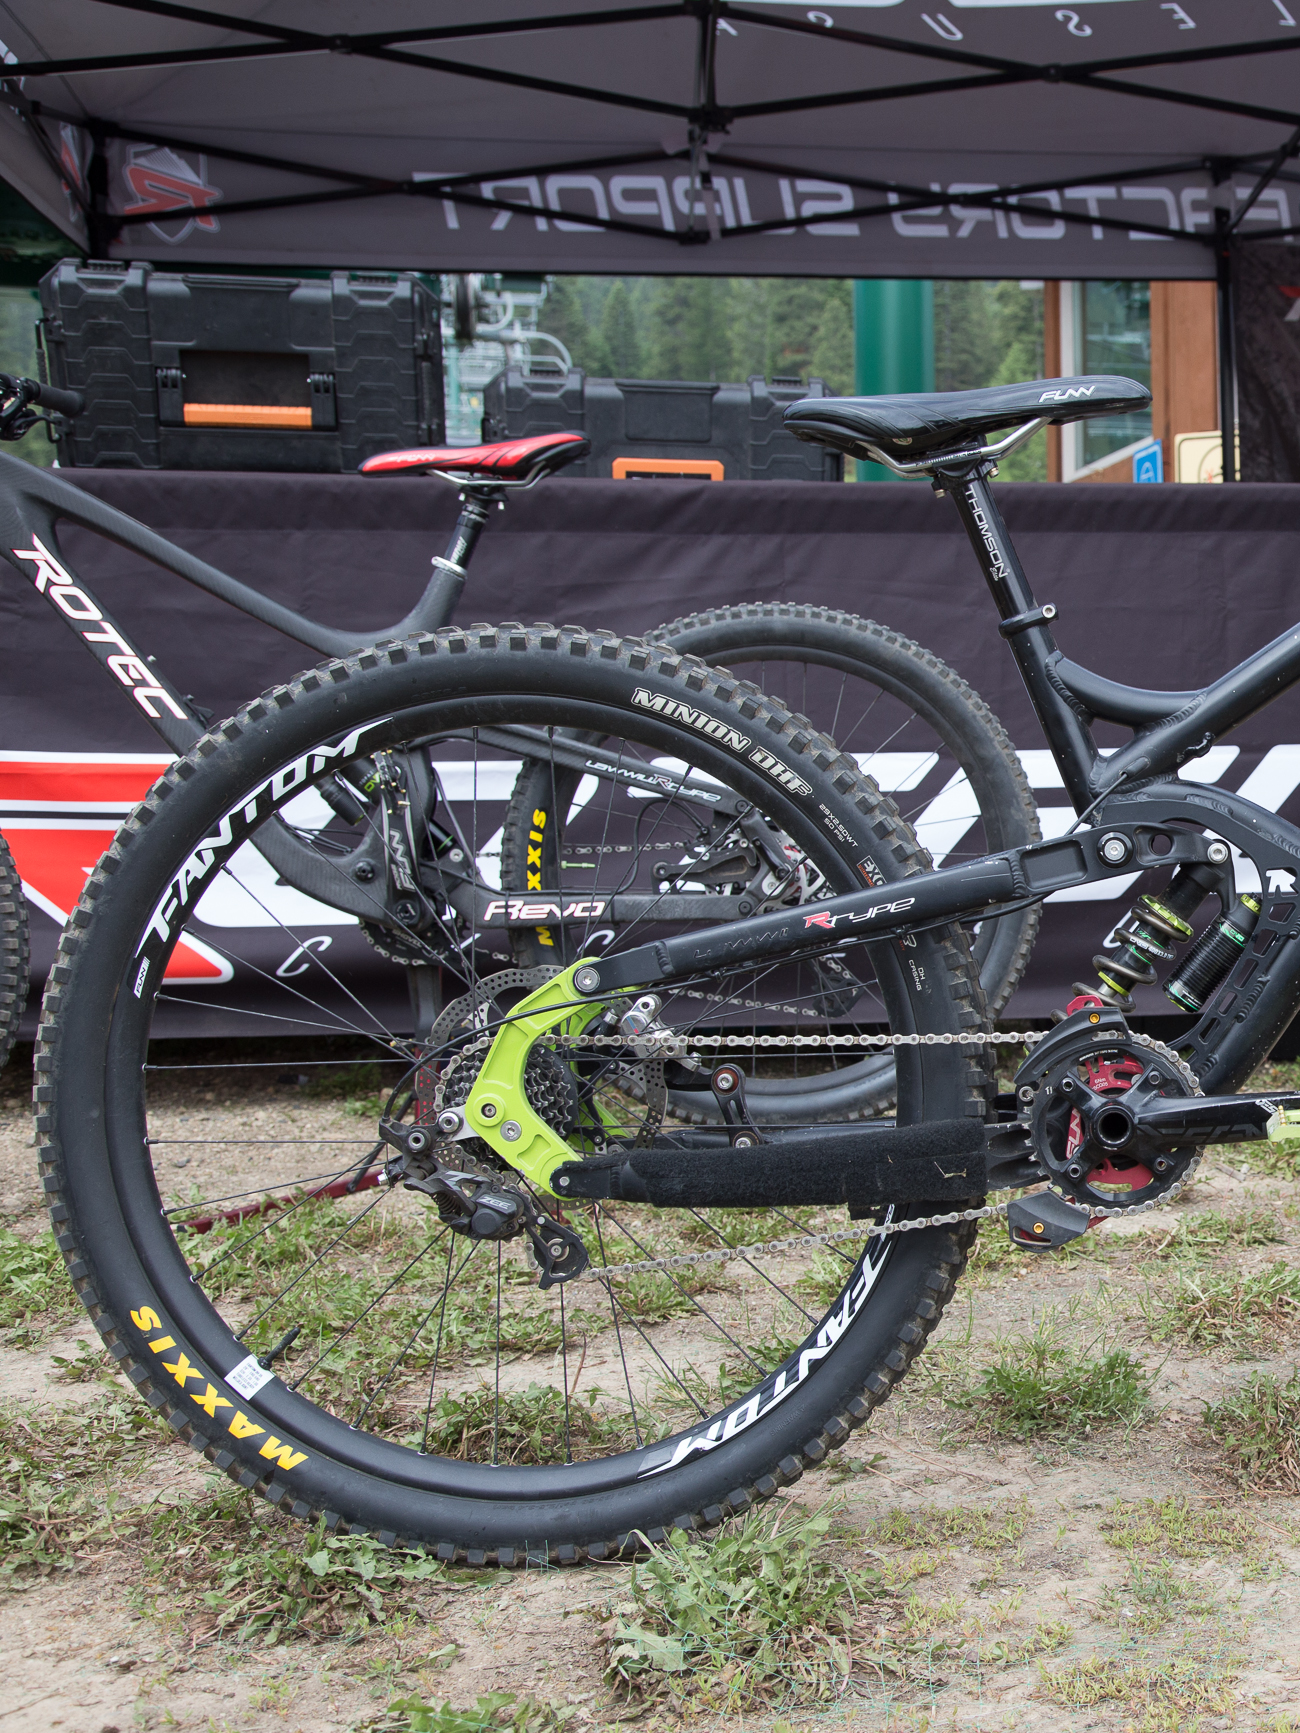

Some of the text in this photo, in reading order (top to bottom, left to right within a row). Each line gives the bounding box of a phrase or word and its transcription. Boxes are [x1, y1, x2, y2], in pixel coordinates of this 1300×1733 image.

[1039, 386, 1096, 403] FUNN
[964, 484, 1009, 578] THOMSON
[11, 532, 187, 721] ROTEC
[631, 687, 813, 797] MINION DHF
[134, 716, 394, 958] FANTOM
[526, 808, 555, 947] MXXIS
[479, 1197, 512, 1209] ZEE
[129, 1305, 309, 1472] MAXXIS
[637, 1240, 892, 1479] FANTOM
